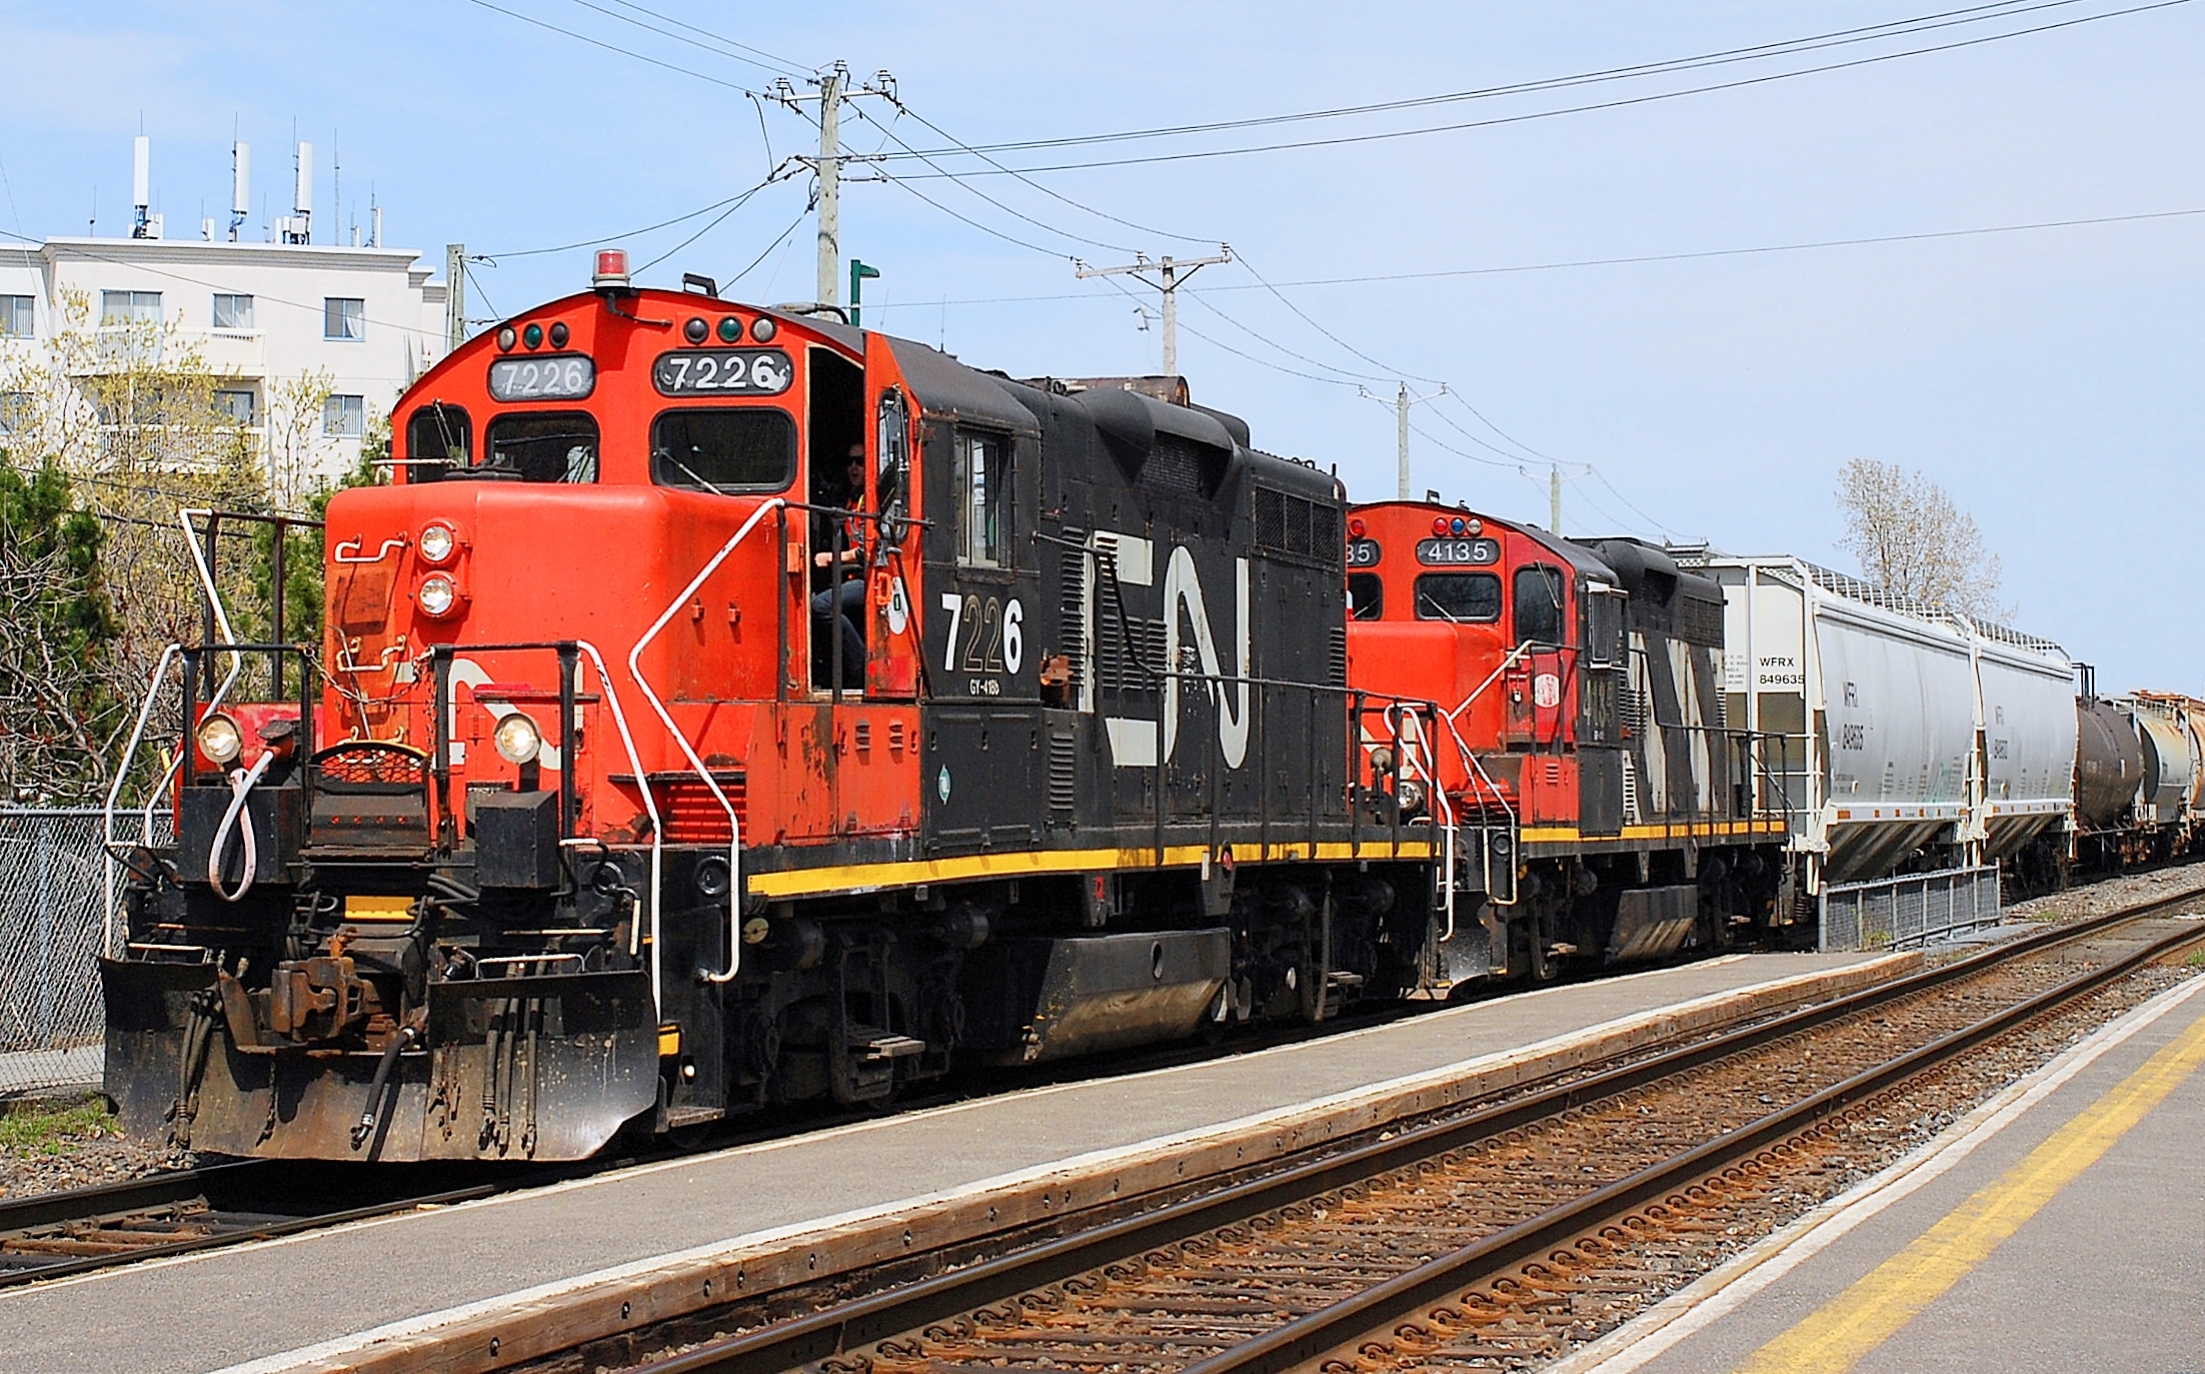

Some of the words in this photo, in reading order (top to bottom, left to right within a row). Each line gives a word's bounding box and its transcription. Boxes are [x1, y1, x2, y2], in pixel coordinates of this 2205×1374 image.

[501, 360, 584, 395] 7226
[670, 355, 778, 392] 7226
[1346, 542, 1371, 563] 35
[1428, 541, 1488, 562] 4135
[941, 593, 1023, 675] 7226
[1078, 530, 1250, 769] CN
[1759, 657, 1794, 667] WFRX
[1759, 674, 1805, 685] 849635
